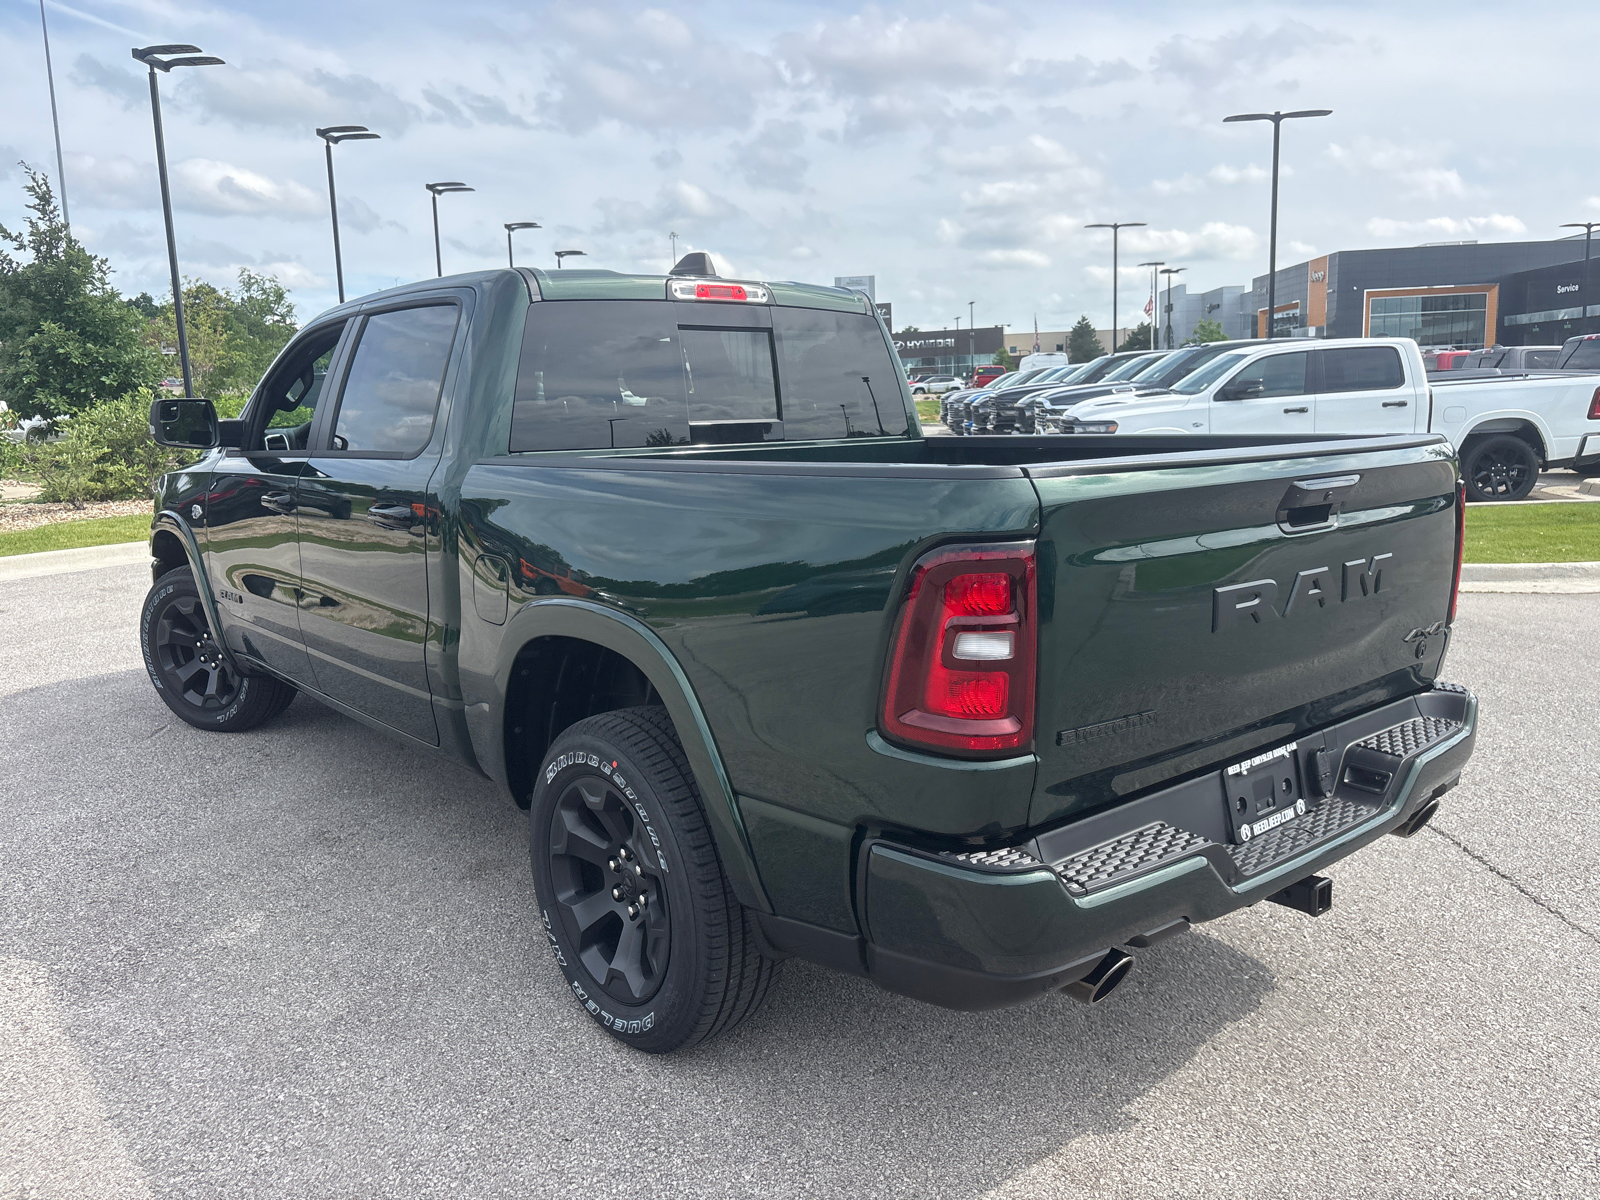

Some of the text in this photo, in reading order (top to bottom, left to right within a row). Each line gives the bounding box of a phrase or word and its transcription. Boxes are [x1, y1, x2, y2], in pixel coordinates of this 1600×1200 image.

[1310, 270, 1325, 282] Jeep
[1557, 284, 1579, 294] Service
[906, 338, 955, 350] HYUNDAI
[1211, 552, 1393, 634] RAM
[1252, 751, 1273, 766] CHRYSLER
[1287, 742, 1297, 752] RAM
[546, 751, 669, 873] BRIDGESTONE
[1253, 807, 1295, 835] REEDJEEP.COM
[572, 980, 656, 1034] DUELER
